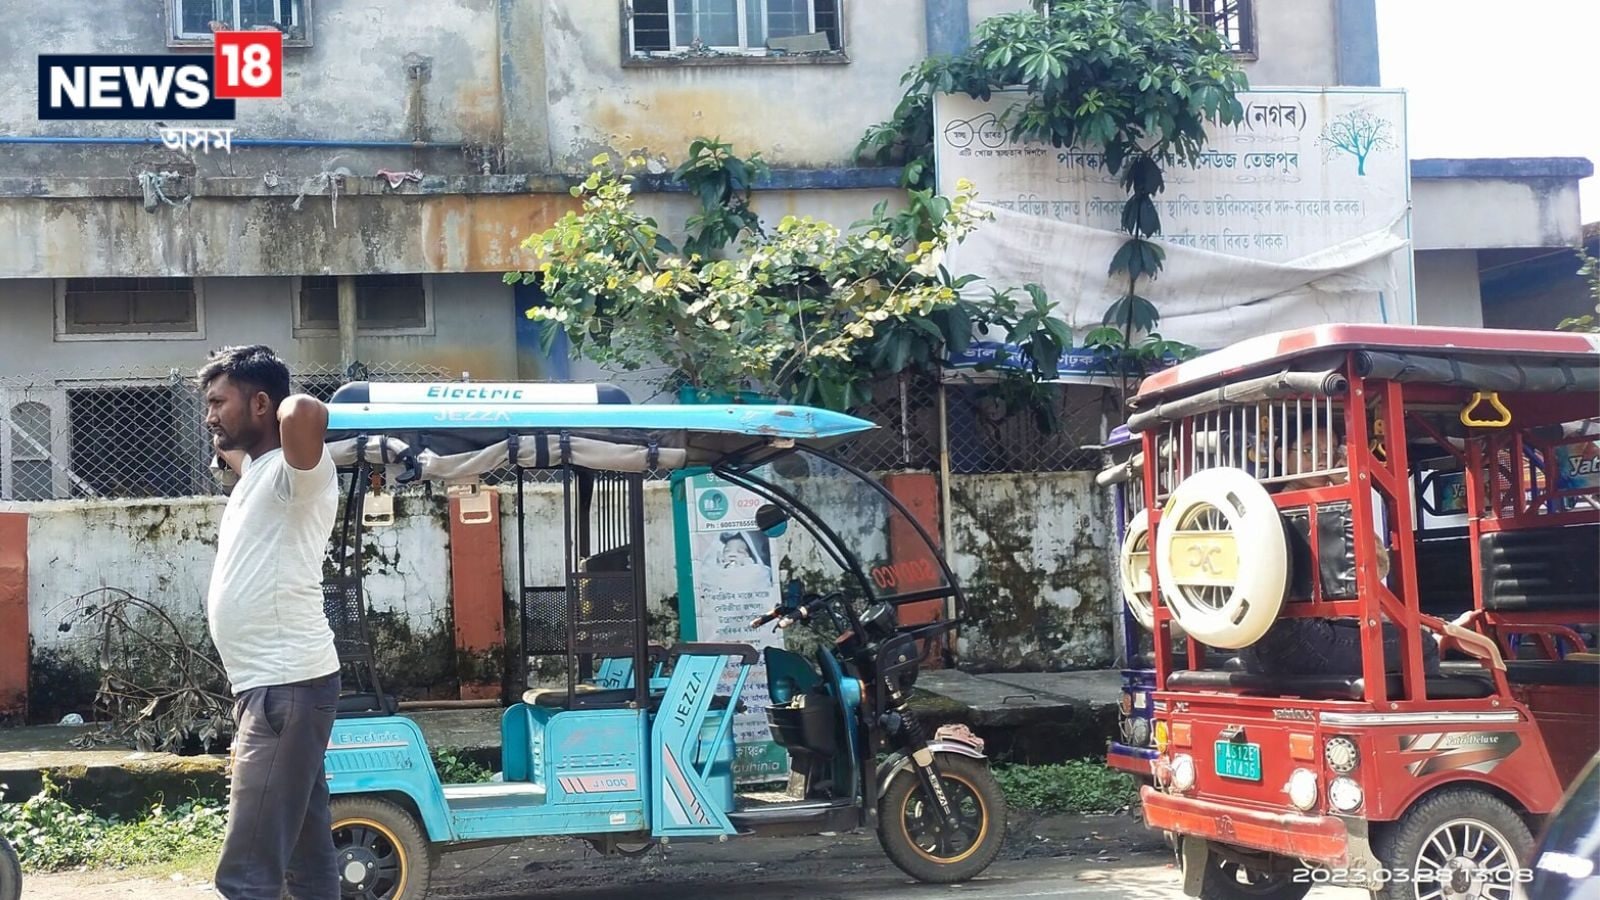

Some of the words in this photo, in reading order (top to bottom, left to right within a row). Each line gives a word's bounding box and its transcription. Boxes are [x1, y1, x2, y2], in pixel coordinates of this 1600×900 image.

[1244, 151, 1299, 173] তেজপুৰ
[426, 385, 523, 400] Electric
[433, 409, 510, 422] JEZZA
[737, 499, 760, 508] 0290
[675, 672, 704, 727] JEZZA
[339, 731, 400, 743] Electric
